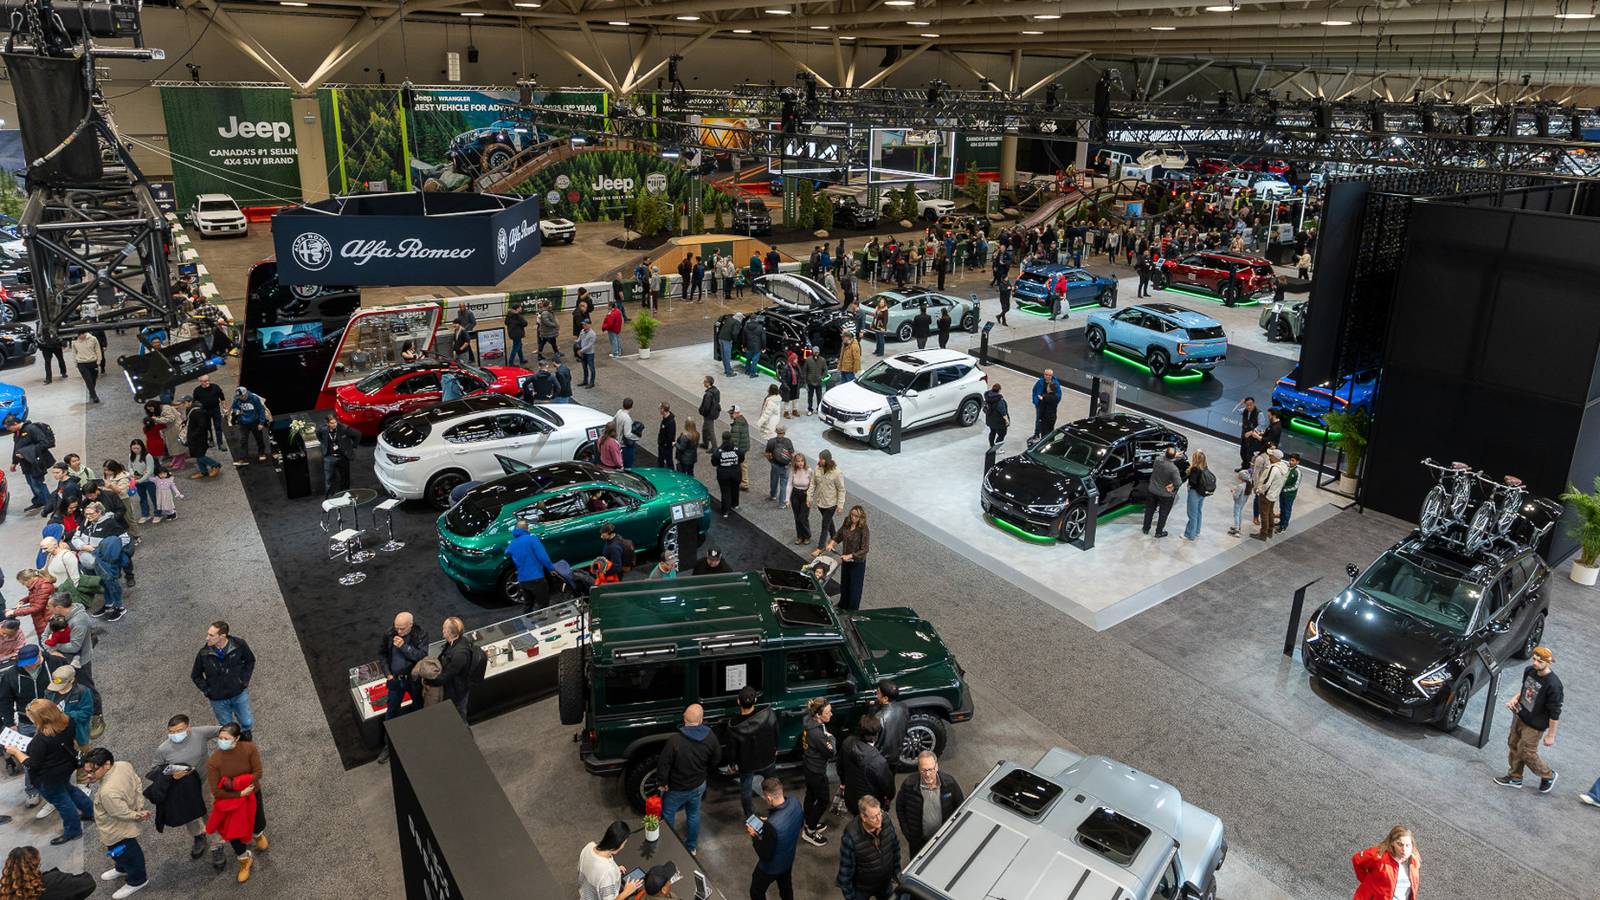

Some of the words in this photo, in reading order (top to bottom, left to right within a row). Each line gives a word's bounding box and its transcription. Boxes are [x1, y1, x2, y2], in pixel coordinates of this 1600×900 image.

[414, 94, 432, 102] Jeep
[436, 103, 470, 112] VEHICLE
[470, 103, 487, 112] FOR
[575, 104, 597, 112] YEAR)
[217, 115, 291, 142] Jeep
[209, 148, 256, 157] CANADA'S
[257, 148, 268, 156] #1
[270, 148, 298, 156] SELLIN
[223, 158, 241, 166] 4X4
[243, 158, 261, 166] SUV
[263, 157, 294, 165] BRAND
[592, 175, 634, 193] Jeep
[294, 235, 306, 252] ALFA
[307, 234, 330, 253] ROMEO
[340, 238, 397, 266] Alfa
[396, 238, 476, 259] Romeo
